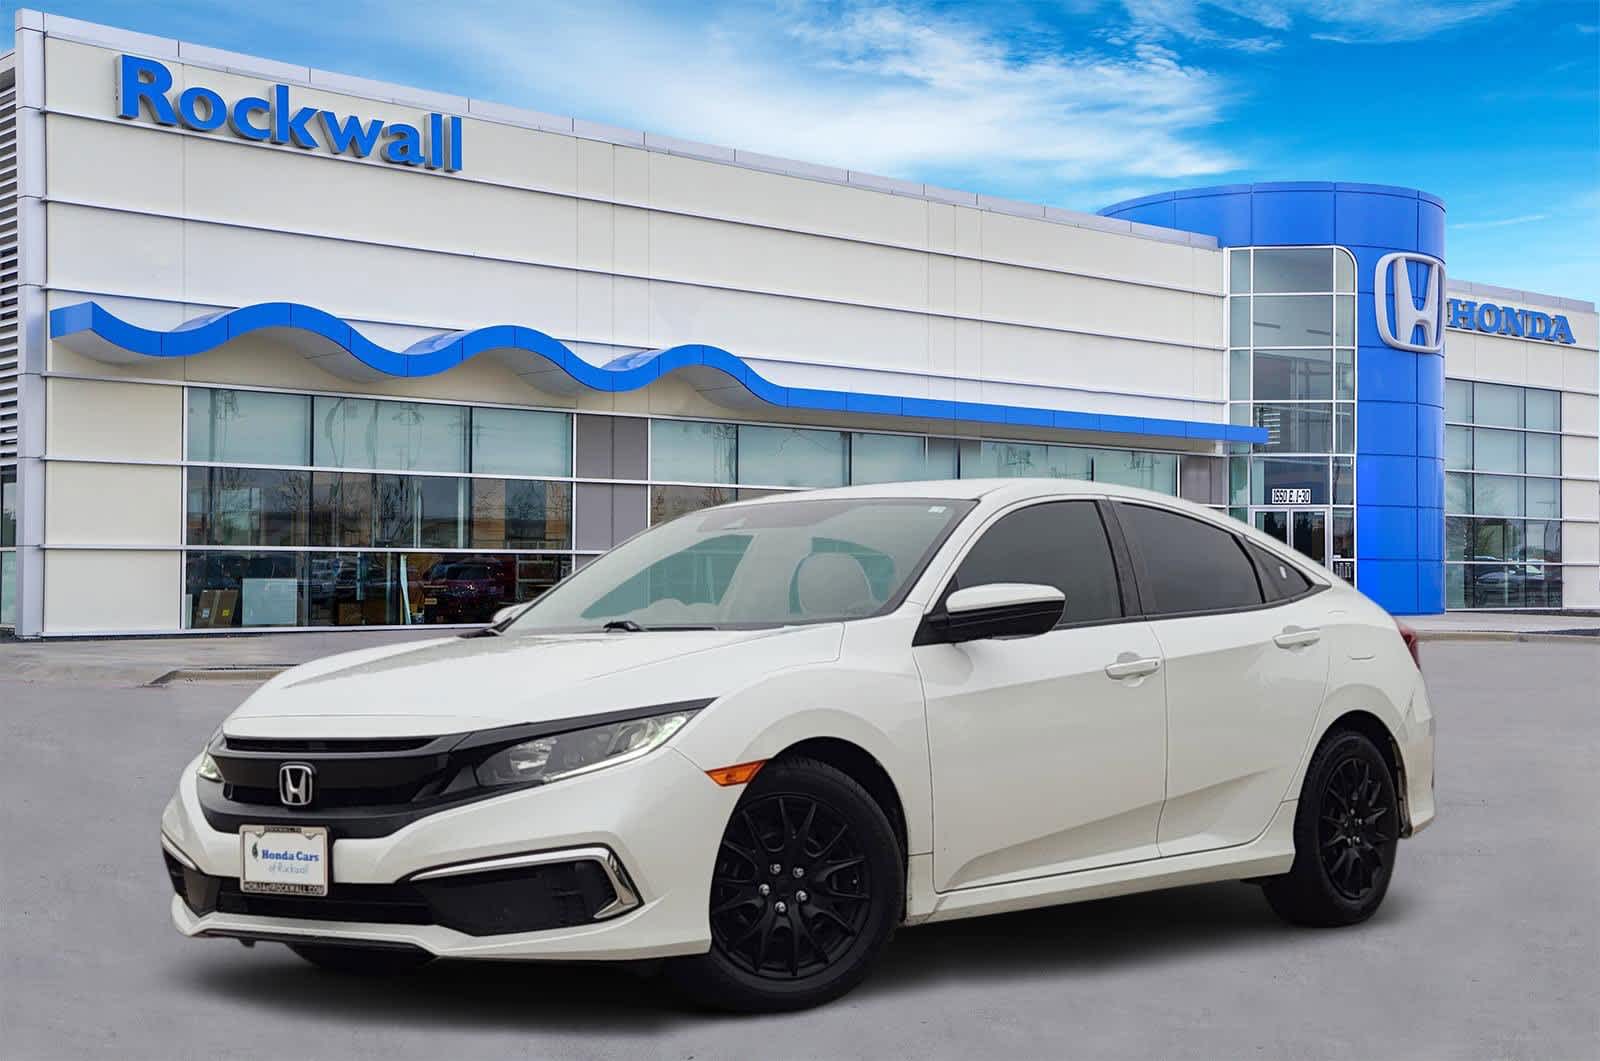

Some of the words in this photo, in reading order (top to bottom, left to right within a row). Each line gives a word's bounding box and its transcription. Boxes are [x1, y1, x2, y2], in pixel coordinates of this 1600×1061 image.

[117, 54, 463, 173] Rockwall
[1448, 298, 1576, 344] HONDA
[262, 849, 294, 861] Honda
[296, 852, 320, 862] Cars
